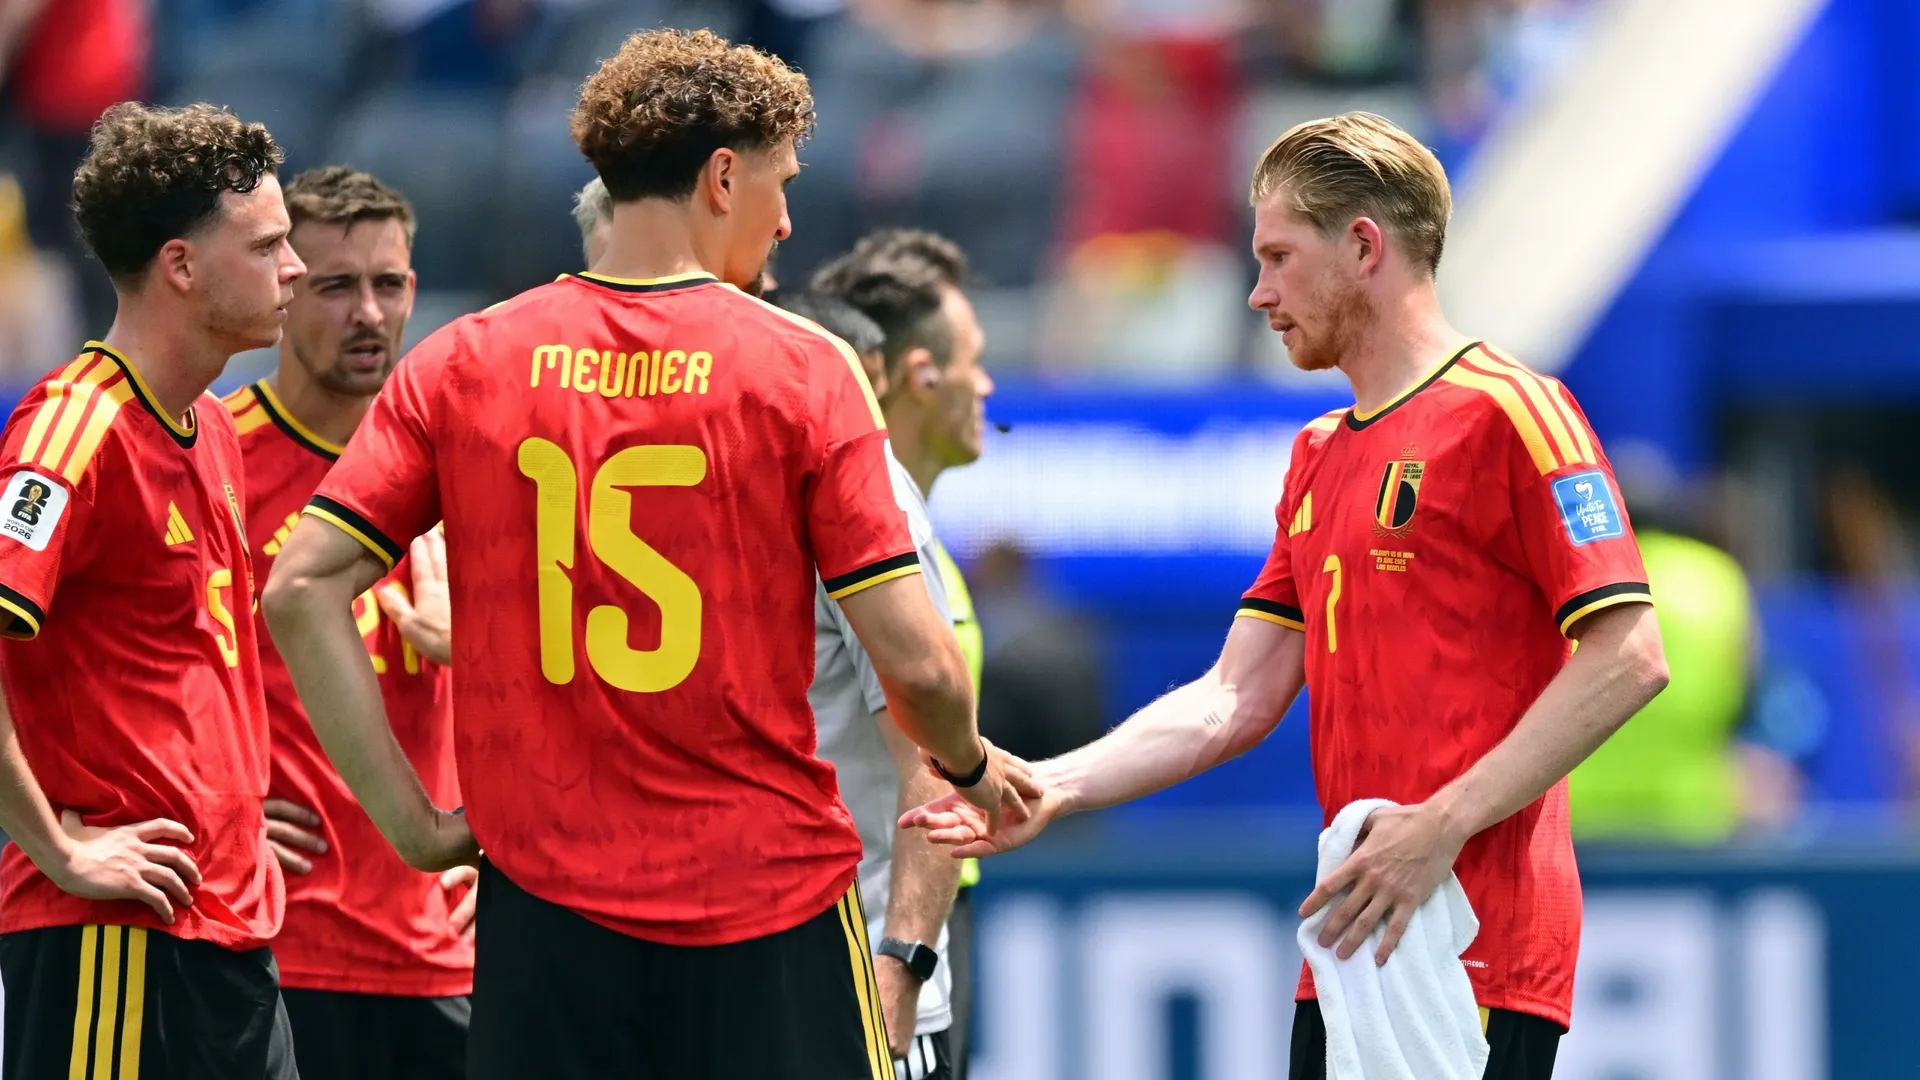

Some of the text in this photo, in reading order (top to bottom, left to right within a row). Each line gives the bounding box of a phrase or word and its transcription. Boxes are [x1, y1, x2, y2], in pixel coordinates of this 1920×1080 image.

[530, 345, 712, 398] MEUNIER
[17, 510, 32, 521] FIFA
[1581, 511, 1609, 528] PEACE
[3, 523, 32, 540] 2026
[6, 518, 35, 533] WORLD CUP
[517, 437, 707, 693] 15
